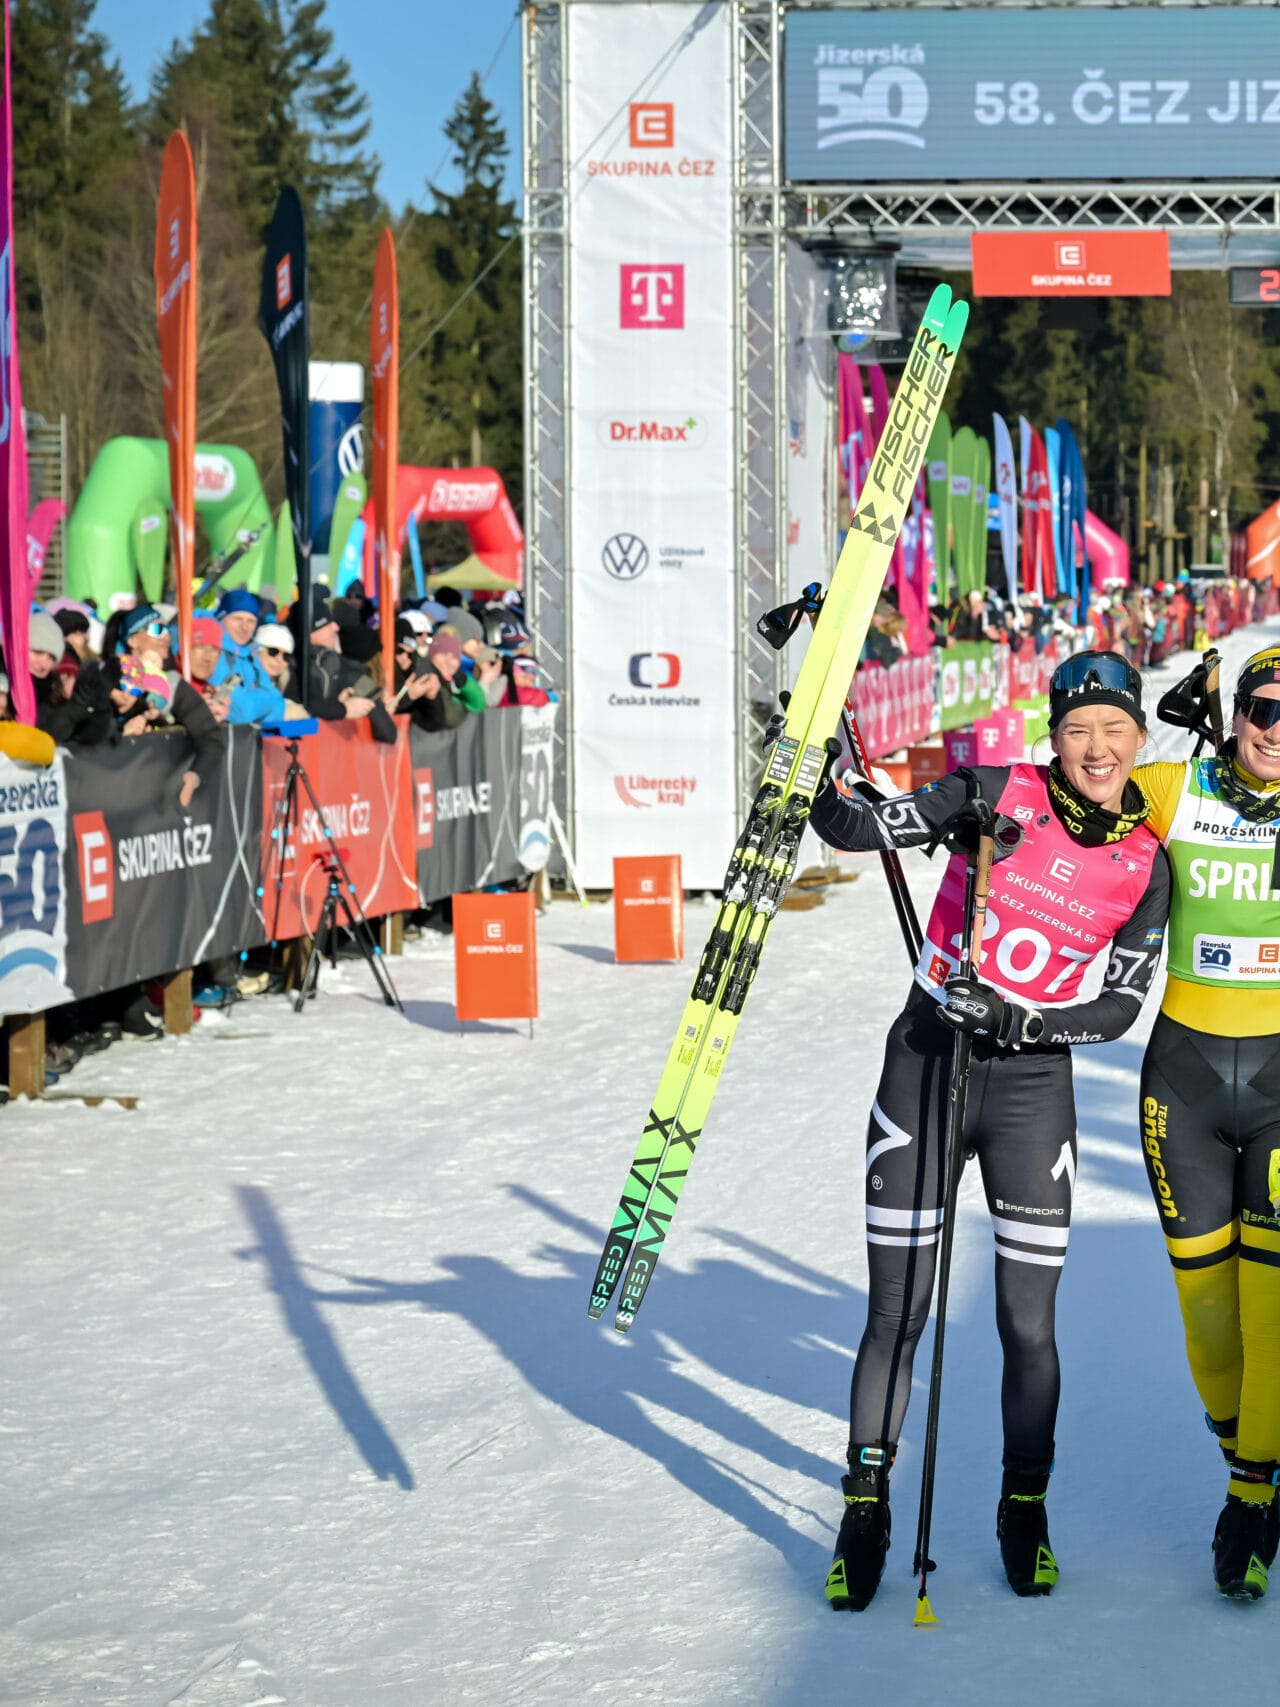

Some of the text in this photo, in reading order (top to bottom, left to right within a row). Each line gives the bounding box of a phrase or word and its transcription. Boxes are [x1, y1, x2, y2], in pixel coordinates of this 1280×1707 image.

[812, 42, 926, 66] Jizerská
[816, 68, 930, 131] 50
[973, 80, 1055, 126] 58.
[1071, 68, 1190, 126] ČEZ
[586, 156, 715, 178] SKUPINA ČEZ
[1031, 273, 1111, 287] SKUPINA ČEZ
[873, 327, 937, 492] FISCHER
[610, 421, 687, 441] Dr.Max
[892, 342, 954, 505] FISCHER
[629, 775, 697, 793] Liberecký
[658, 790, 685, 807] kraj
[118, 816, 213, 882] SKUPINA ČEZ
[1005, 871, 1096, 920] SKUPINA ČEZ
[1000, 893, 1024, 914] ČEZ
[1025, 903, 1084, 938] JIZERSKÁ
[1084, 933, 1097, 945] 50
[1200, 940, 1232, 950] Jizerská
[1200, 948, 1232, 967] 50
[1238, 966, 1277, 975] SKUPINA
[1156, 1103, 1168, 1139] TEAM
[1144, 1096, 1179, 1219] engcon
[1003, 1203, 1065, 1216] SAFEROAD
